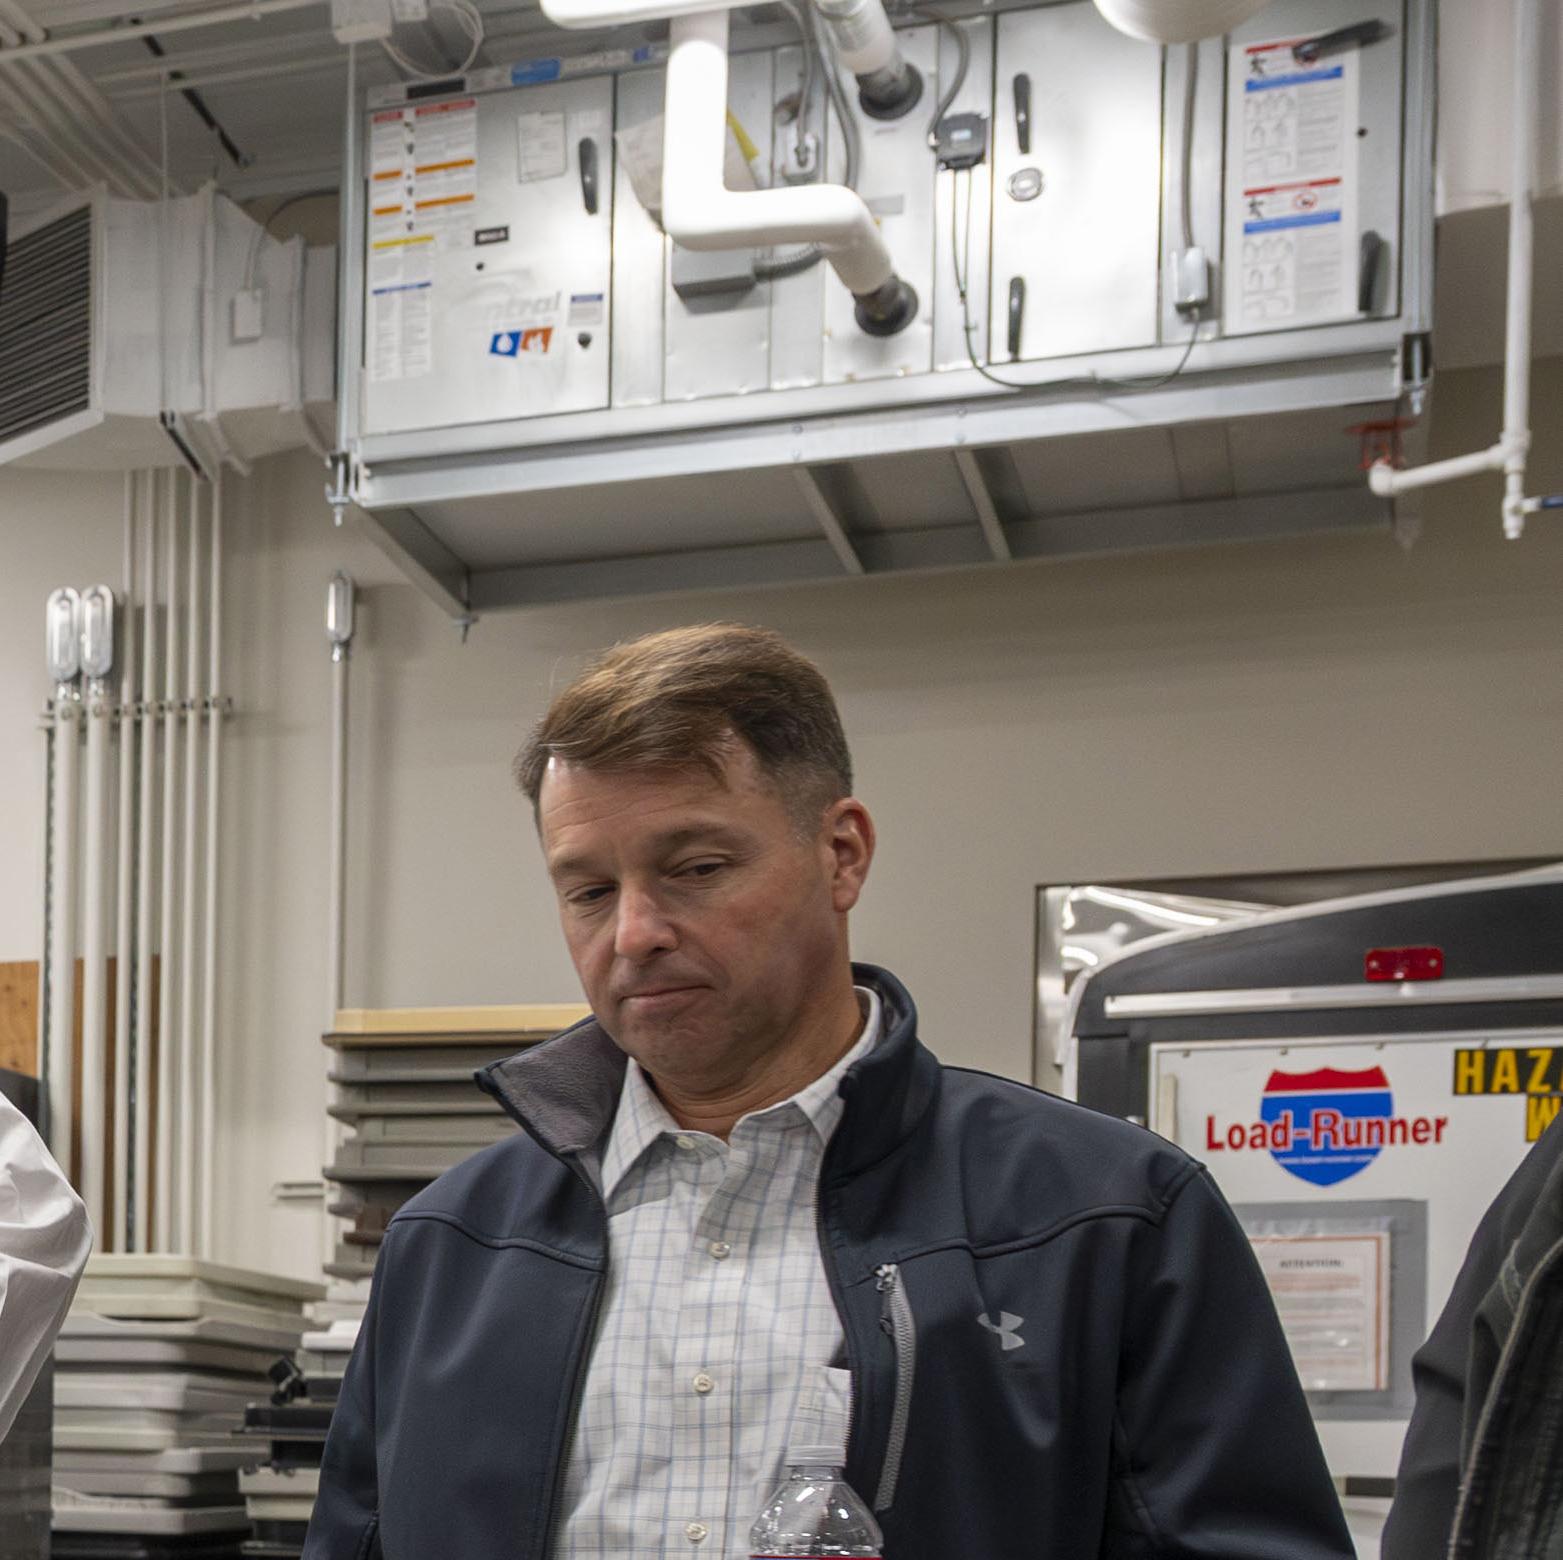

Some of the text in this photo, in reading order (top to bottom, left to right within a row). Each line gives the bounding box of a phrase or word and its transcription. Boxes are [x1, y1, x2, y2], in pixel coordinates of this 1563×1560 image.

[1455, 1048, 1563, 1095] HAZ
[1206, 1109, 1449, 1151] Load-Runner
[1525, 1096, 1563, 1143] W
